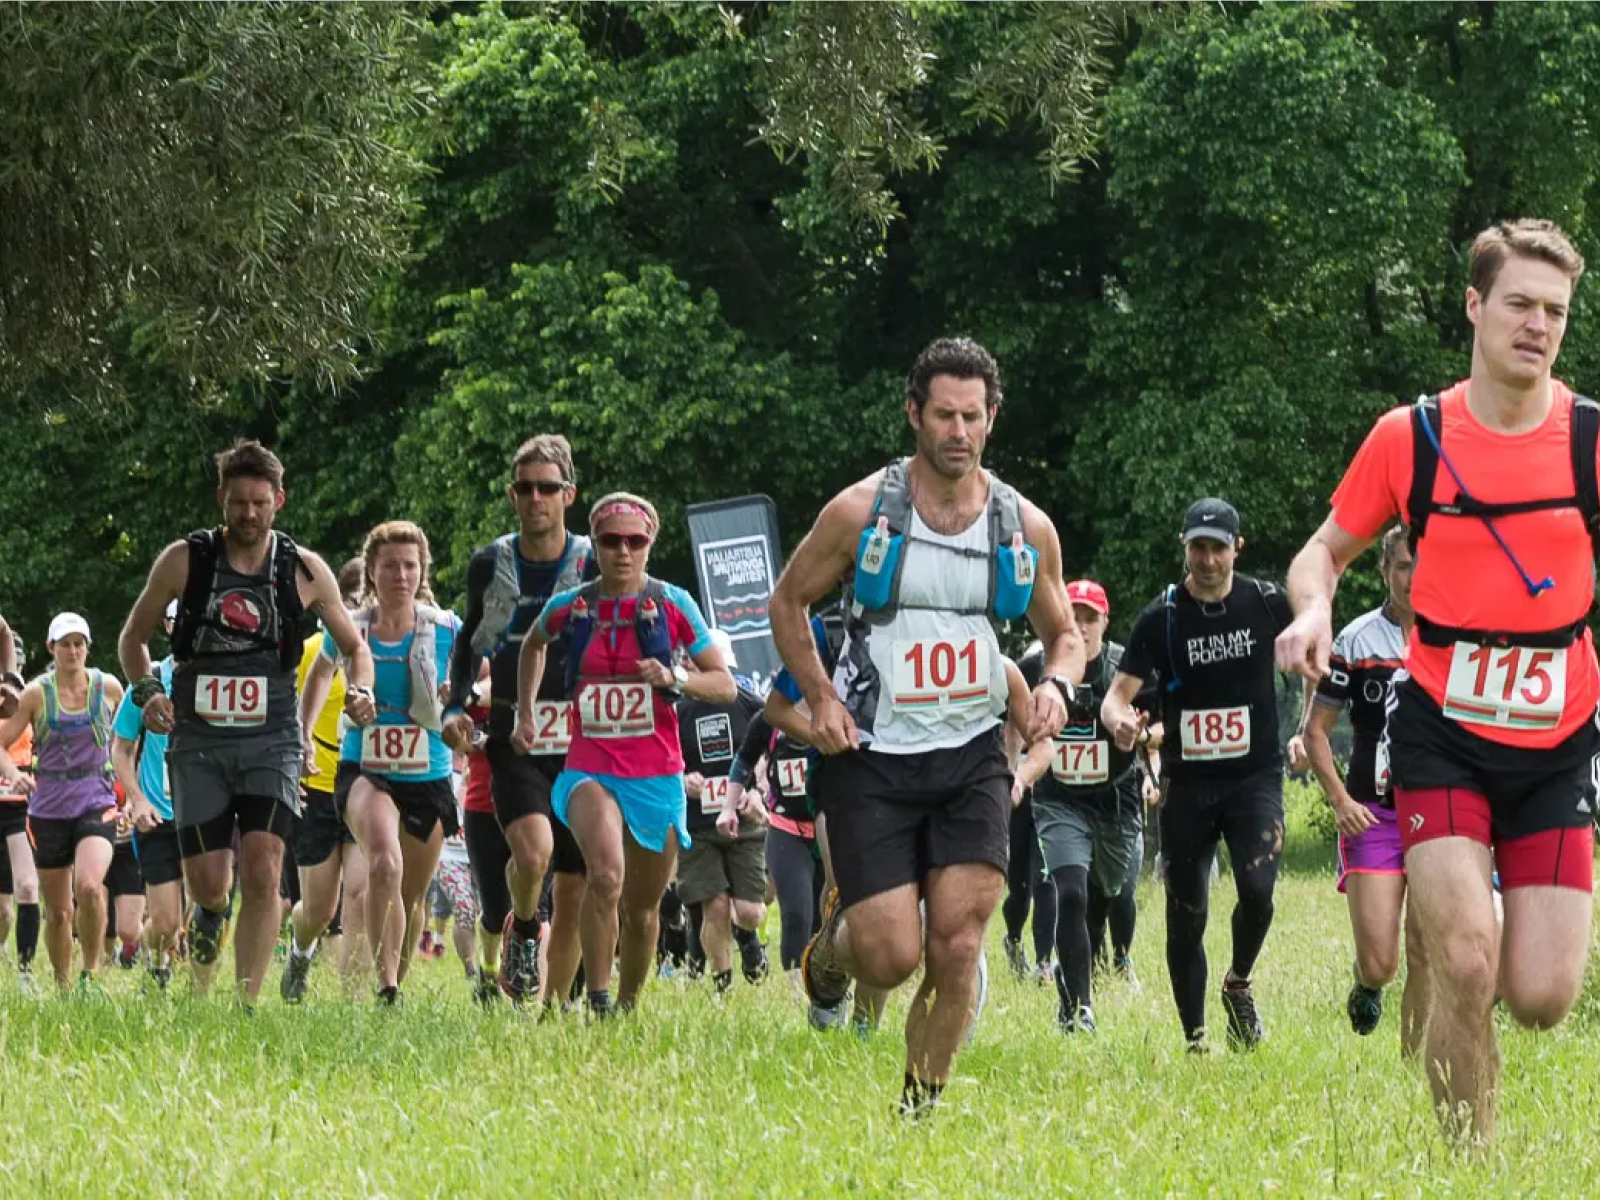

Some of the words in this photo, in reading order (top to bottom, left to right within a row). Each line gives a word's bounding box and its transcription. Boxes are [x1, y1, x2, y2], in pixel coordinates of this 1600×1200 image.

[1187, 636, 1205, 653] PT
[1209, 633, 1224, 648] IN
[1228, 627, 1251, 648] MY
[1189, 639, 1257, 667] POCKET
[904, 639, 977, 689] 101
[1467, 647, 1555, 705] 115
[205, 677, 260, 712] 119
[587, 687, 647, 722] 102
[539, 703, 573, 739] 21
[1187, 711, 1245, 745] 185
[369, 728, 421, 760] 187
[1057, 743, 1099, 771] 171
[783, 760, 805, 786] 11
[704, 779, 728, 801] 14
